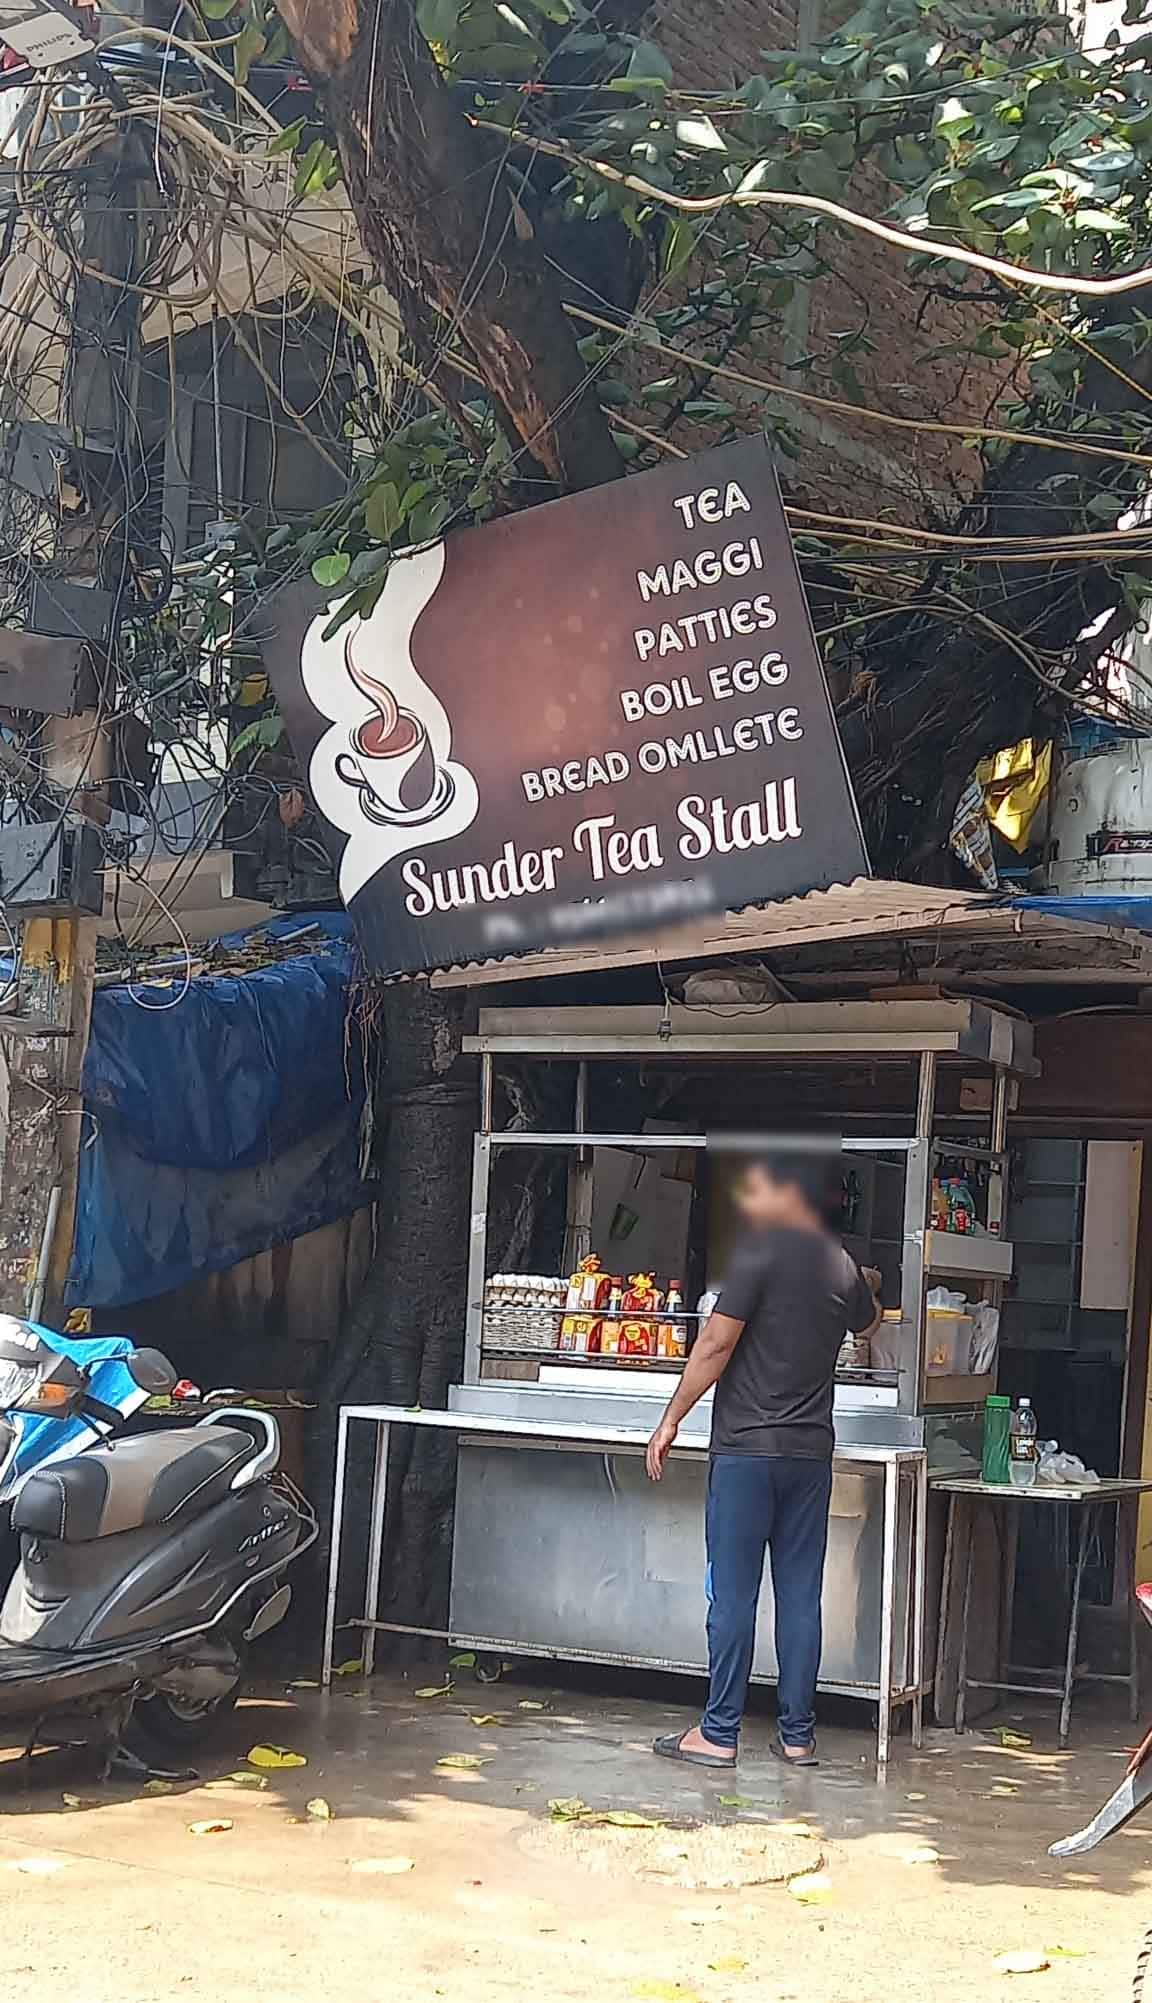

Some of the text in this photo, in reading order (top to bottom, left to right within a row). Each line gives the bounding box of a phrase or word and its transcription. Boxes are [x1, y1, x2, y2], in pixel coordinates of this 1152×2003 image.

[674, 482, 751, 529] TEA
[637, 538, 763, 602] MAGGI
[634, 595, 777, 661] PATTIES
[621, 652, 788, 722] BOIL EGG
[522, 708, 804, 802] BREAD OMLLETE
[402, 841, 563, 917] Sunder
[574, 815, 664, 880] Tea
[677, 777, 802, 860] Stall
